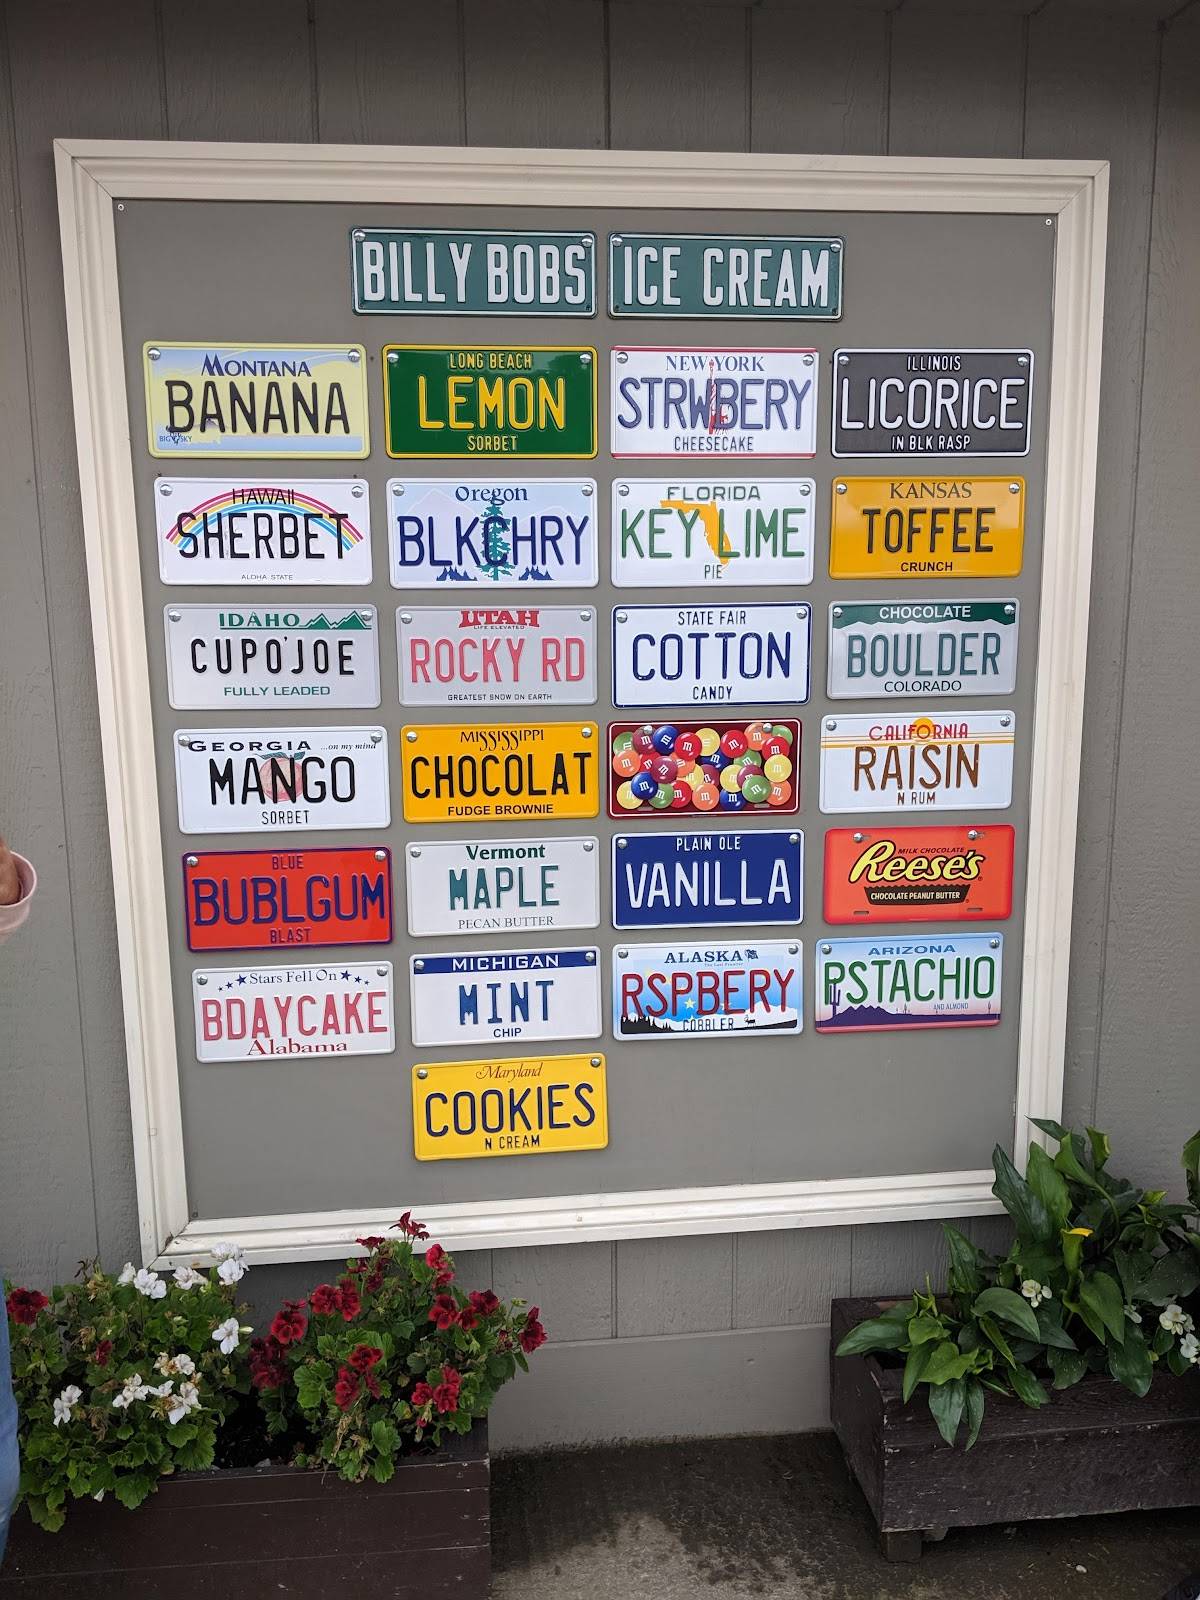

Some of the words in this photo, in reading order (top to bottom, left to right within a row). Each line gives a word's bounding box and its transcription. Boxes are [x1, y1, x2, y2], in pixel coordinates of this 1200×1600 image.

[362, 241, 472, 303] BILLY
[487, 244, 587, 304] BOBS
[624, 246, 681, 305] ICE
[703, 248, 829, 307] CREAM
[201, 353, 311, 377] MONTANA
[450, 353, 484, 369] LONG
[489, 354, 532, 369] BEACH
[666, 355, 710, 371] NEW
[715, 356, 765, 371] YORK
[907, 355, 961, 371] ILLINOIS
[165, 380, 350, 433] BANANA
[418, 376, 565, 430] LEMON
[618, 377, 812, 430] STRWBERY
[841, 378, 1025, 429] LICORICE
[467, 435, 518, 451] SORBET
[674, 436, 754, 451] CHEESECAKE
[892, 436, 904, 450] IN
[909, 436, 933, 450] BLK
[939, 435, 970, 450] RASP
[232, 488, 295, 505] HAWAII
[455, 486, 528, 505] Oregon
[668, 486, 760, 500] FLORIDA
[890, 482, 972, 499] KANSAS
[177, 512, 348, 559] SHERBET
[621, 508, 700, 558] KEY
[718, 508, 806, 558] LIME
[863, 508, 995, 553] TOFFEE
[397, 516, 589, 566] BLKCHRY
[704, 565, 722, 579] PIE
[901, 562, 953, 571] CRUNCH
[219, 613, 299, 627] IDAHO
[459, 610, 540, 628] UTAH
[678, 611, 714, 625] STATE
[720, 610, 746, 624] FAIR
[879, 606, 971, 619] CHOCOLATE
[191, 637, 354, 675] CUPO'JOE
[410, 638, 525, 683] ROCKY
[542, 638, 585, 682] RD
[633, 632, 791, 680] COTTON
[848, 633, 1001, 678] BOULDER
[224, 687, 269, 696] FULLY
[274, 686, 330, 695] LEADED
[693, 686, 733, 700] CANDY
[884, 681, 962, 692] COLORADO
[460, 729, 544, 751] MISSISSIPPI
[869, 723, 968, 741] CALIFORNIA
[188, 740, 311, 752] GEORGIA
[411, 753, 591, 798] CHOCOLAT
[854, 743, 979, 791] RAISIN
[209, 756, 355, 805] MANGO
[912, 791, 935, 805] RUM
[262, 810, 309, 824] SORBET
[448, 806, 490, 816] FUDGE
[495, 804, 553, 814] BROWNIE
[466, 844, 545, 860] Vermont
[677, 837, 711, 851] PLAIN
[719, 837, 741, 850] OLE
[272, 855, 303, 870] BLUE
[848, 840, 986, 884] Reese's
[449, 865, 559, 910] MAPLE
[626, 859, 791, 908] VANILLA
[192, 873, 385, 925] BUBLGUM
[909, 892, 934, 900] PEANUT
[458, 918, 501, 929] PECAN
[505, 916, 554, 927] BUTTER
[270, 928, 311, 944] BLAST
[664, 950, 743, 964] ALASKA
[868, 945, 956, 955] ARIZONA
[453, 955, 559, 971] MICHIGAN
[249, 973, 282, 984] Stars
[286, 971, 312, 983] Fell
[316, 969, 337, 981] On
[824, 956, 995, 1005] PSTACHIO
[622, 968, 794, 1017] RSPBERY
[459, 980, 554, 1025] MINT
[946, 1002, 969, 1010] ALMOND
[202, 991, 387, 1041] BDAYCAKE
[683, 1017, 734, 1031] COBBLER
[493, 1028, 522, 1038] CHIP
[247, 1038, 347, 1055] Alabama
[476, 1062, 544, 1083] Maryland
[425, 1083, 595, 1137] COOKIES
[485, 1138, 492, 1150] N
[500, 1135, 540, 1149] CREAM
